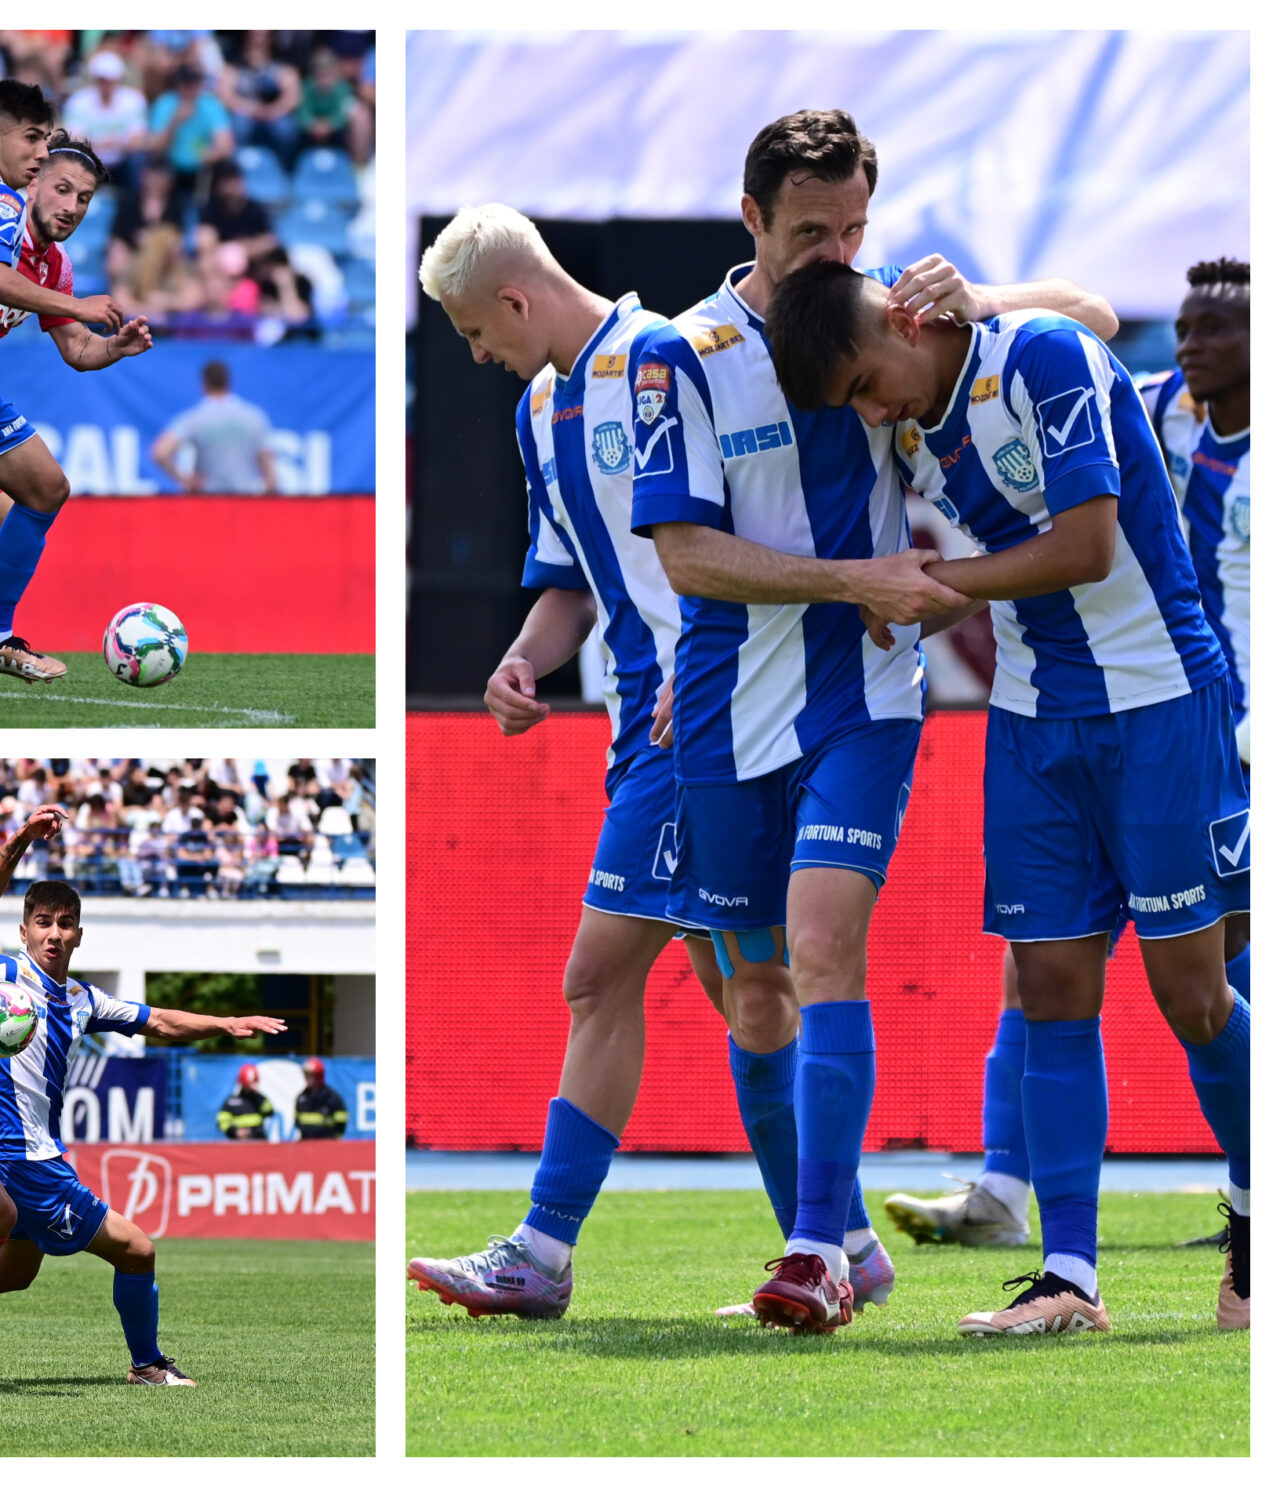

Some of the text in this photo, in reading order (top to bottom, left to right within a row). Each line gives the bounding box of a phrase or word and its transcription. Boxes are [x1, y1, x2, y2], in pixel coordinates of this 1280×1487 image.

[803, 824, 845, 843] FORTUNA
[846, 827, 882, 851] SPORTS
[595, 870, 626, 893] SPORTS
[1170, 884, 1207, 910] SPORTS
